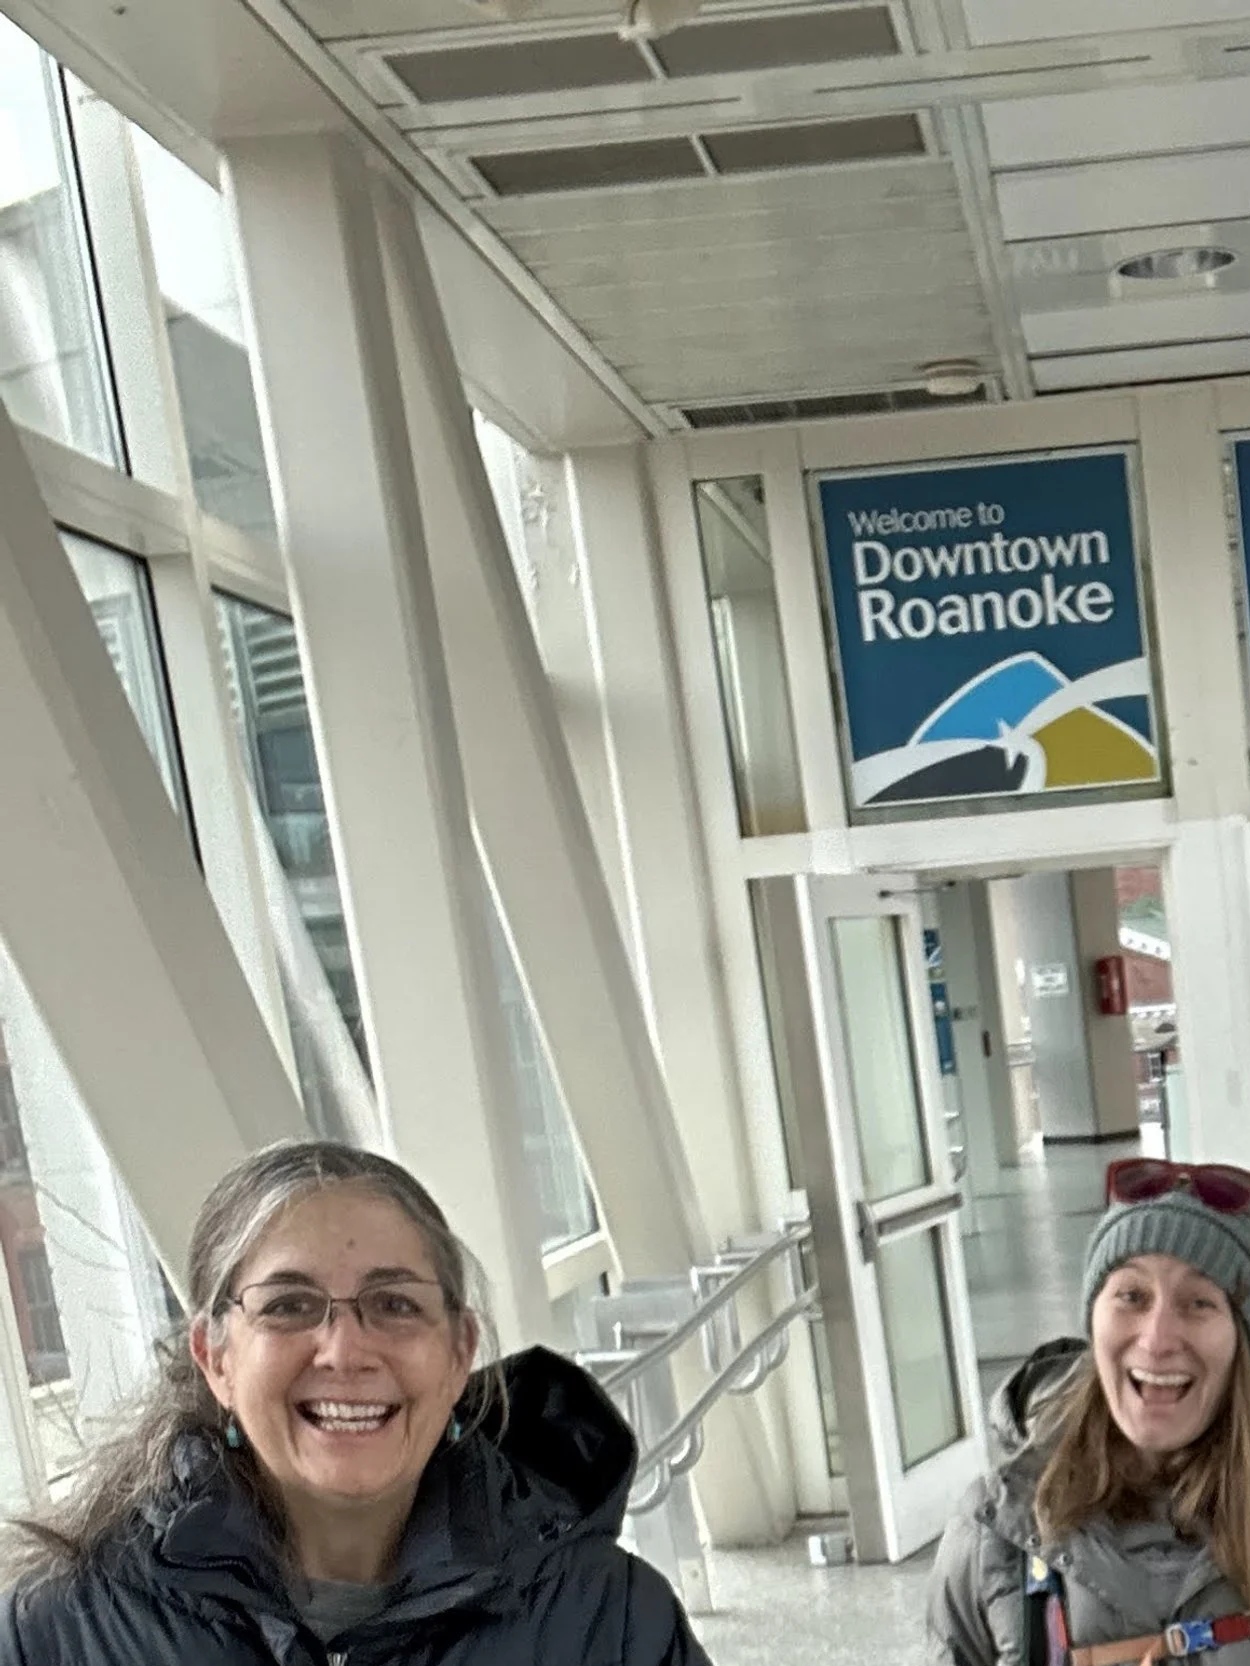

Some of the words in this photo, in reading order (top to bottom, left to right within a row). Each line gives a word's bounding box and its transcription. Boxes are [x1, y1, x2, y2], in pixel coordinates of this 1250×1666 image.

[847, 505, 972, 537] Welcome
[977, 502, 1006, 525] to
[853, 529, 1110, 586] Downtown
[858, 573, 1115, 642] Roanoke
